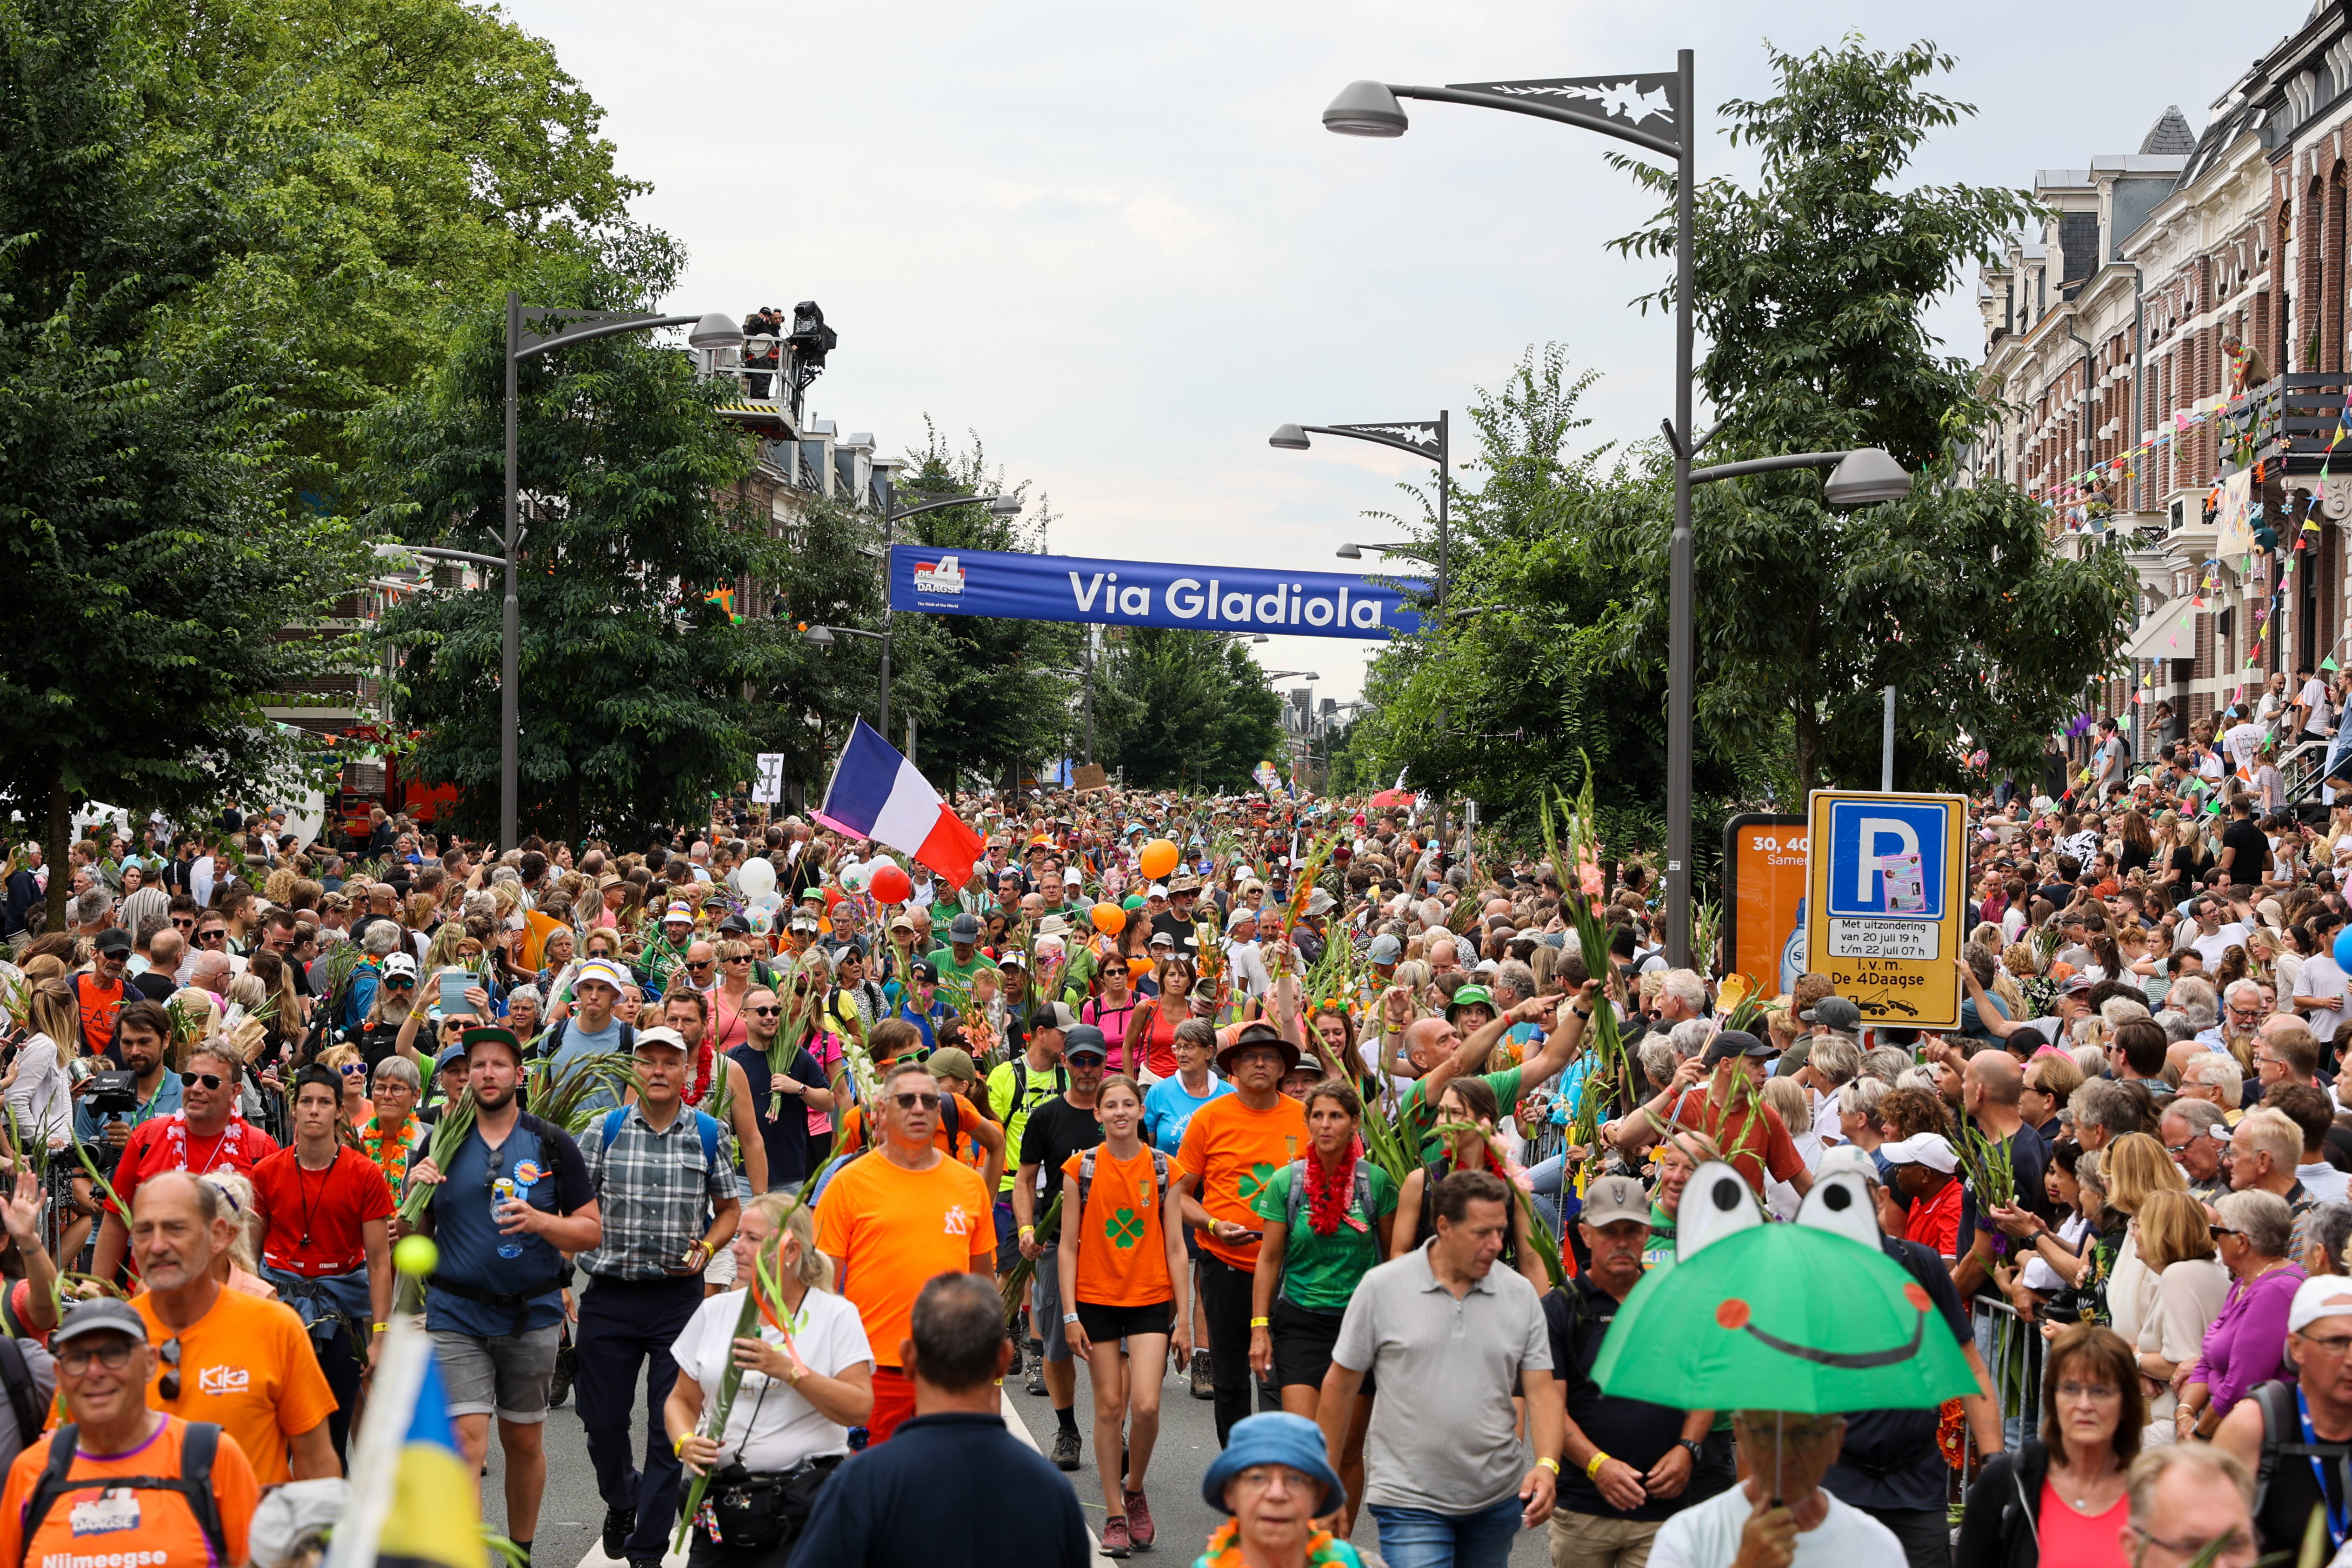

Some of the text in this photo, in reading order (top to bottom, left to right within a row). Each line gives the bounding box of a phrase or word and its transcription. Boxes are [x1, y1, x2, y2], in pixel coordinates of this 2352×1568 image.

[918, 555, 961, 585] DE 4
[917, 583, 960, 594] DAAGSE
[1069, 571, 1382, 629] Via Gladiola
[1752, 837, 1781, 854] 30,
[1858, 818, 1919, 901] P
[1842, 920, 1926, 933] Met uitzondering
[1863, 933, 1877, 941] 20
[1879, 934, 1895, 944] juli
[1899, 934, 1909, 942] 19
[1912, 934, 1919, 943] h
[1840, 945, 1925, 957] t/m 22 juli 07 h
[1832, 972, 1925, 989] De 4Daagse
[1170, 1112, 1191, 1136] wandel
[42, 1549, 168, 1568] Nijmeegse
